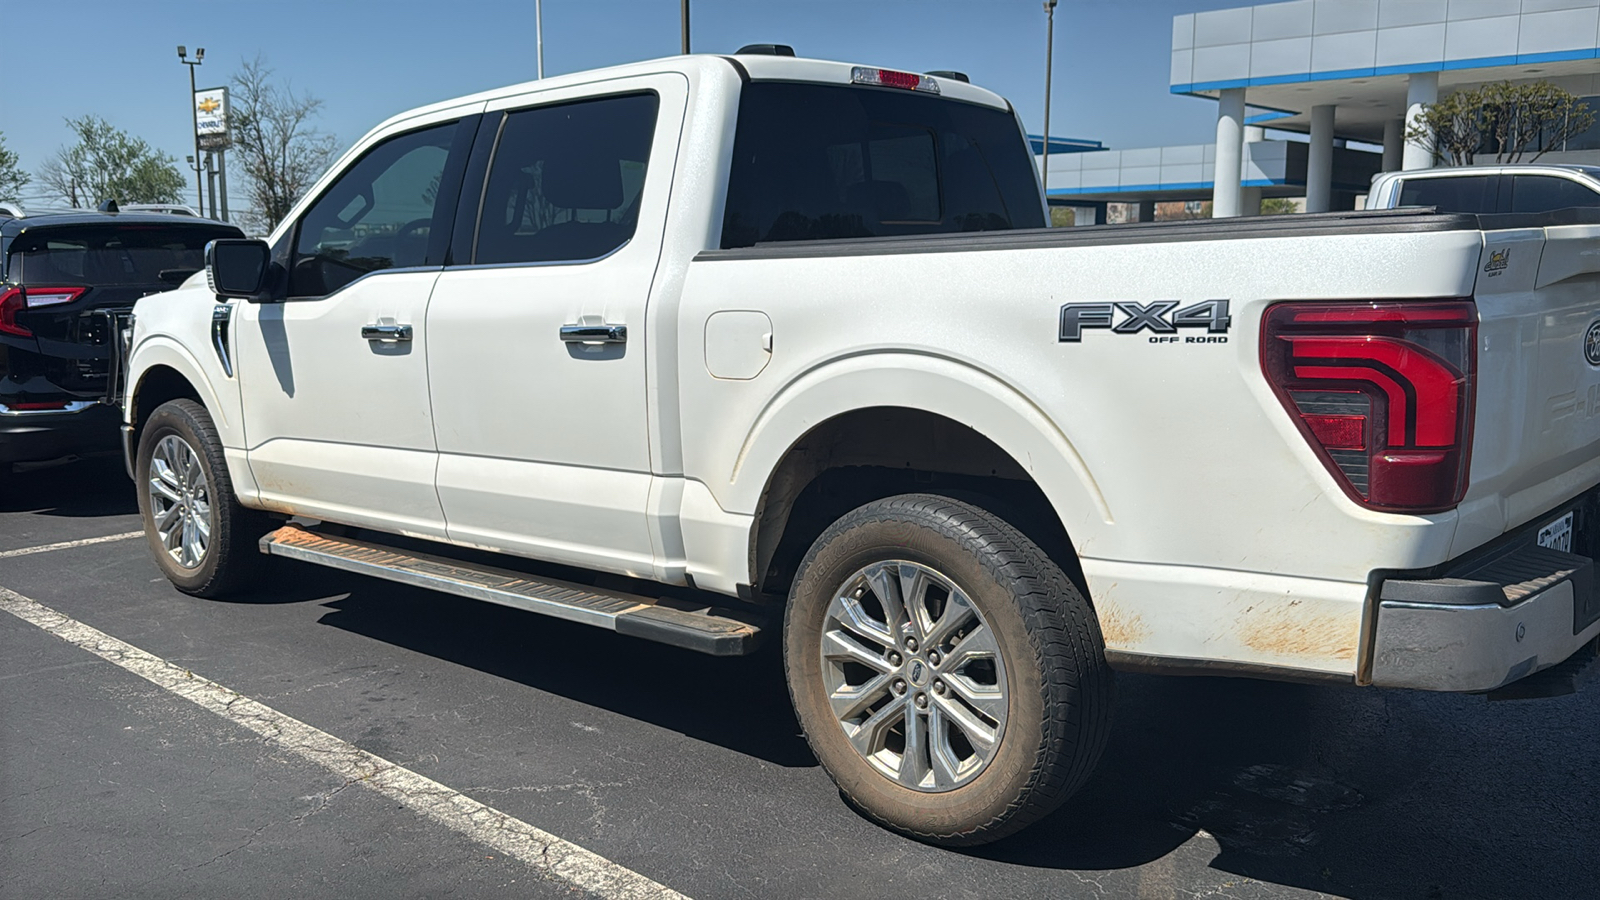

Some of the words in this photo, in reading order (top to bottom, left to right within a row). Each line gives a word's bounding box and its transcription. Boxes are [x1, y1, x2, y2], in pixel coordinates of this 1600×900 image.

[1058, 299, 1231, 343] FX4
[1148, 336, 1180, 344] OFF
[1185, 336, 1228, 344] ROAD
